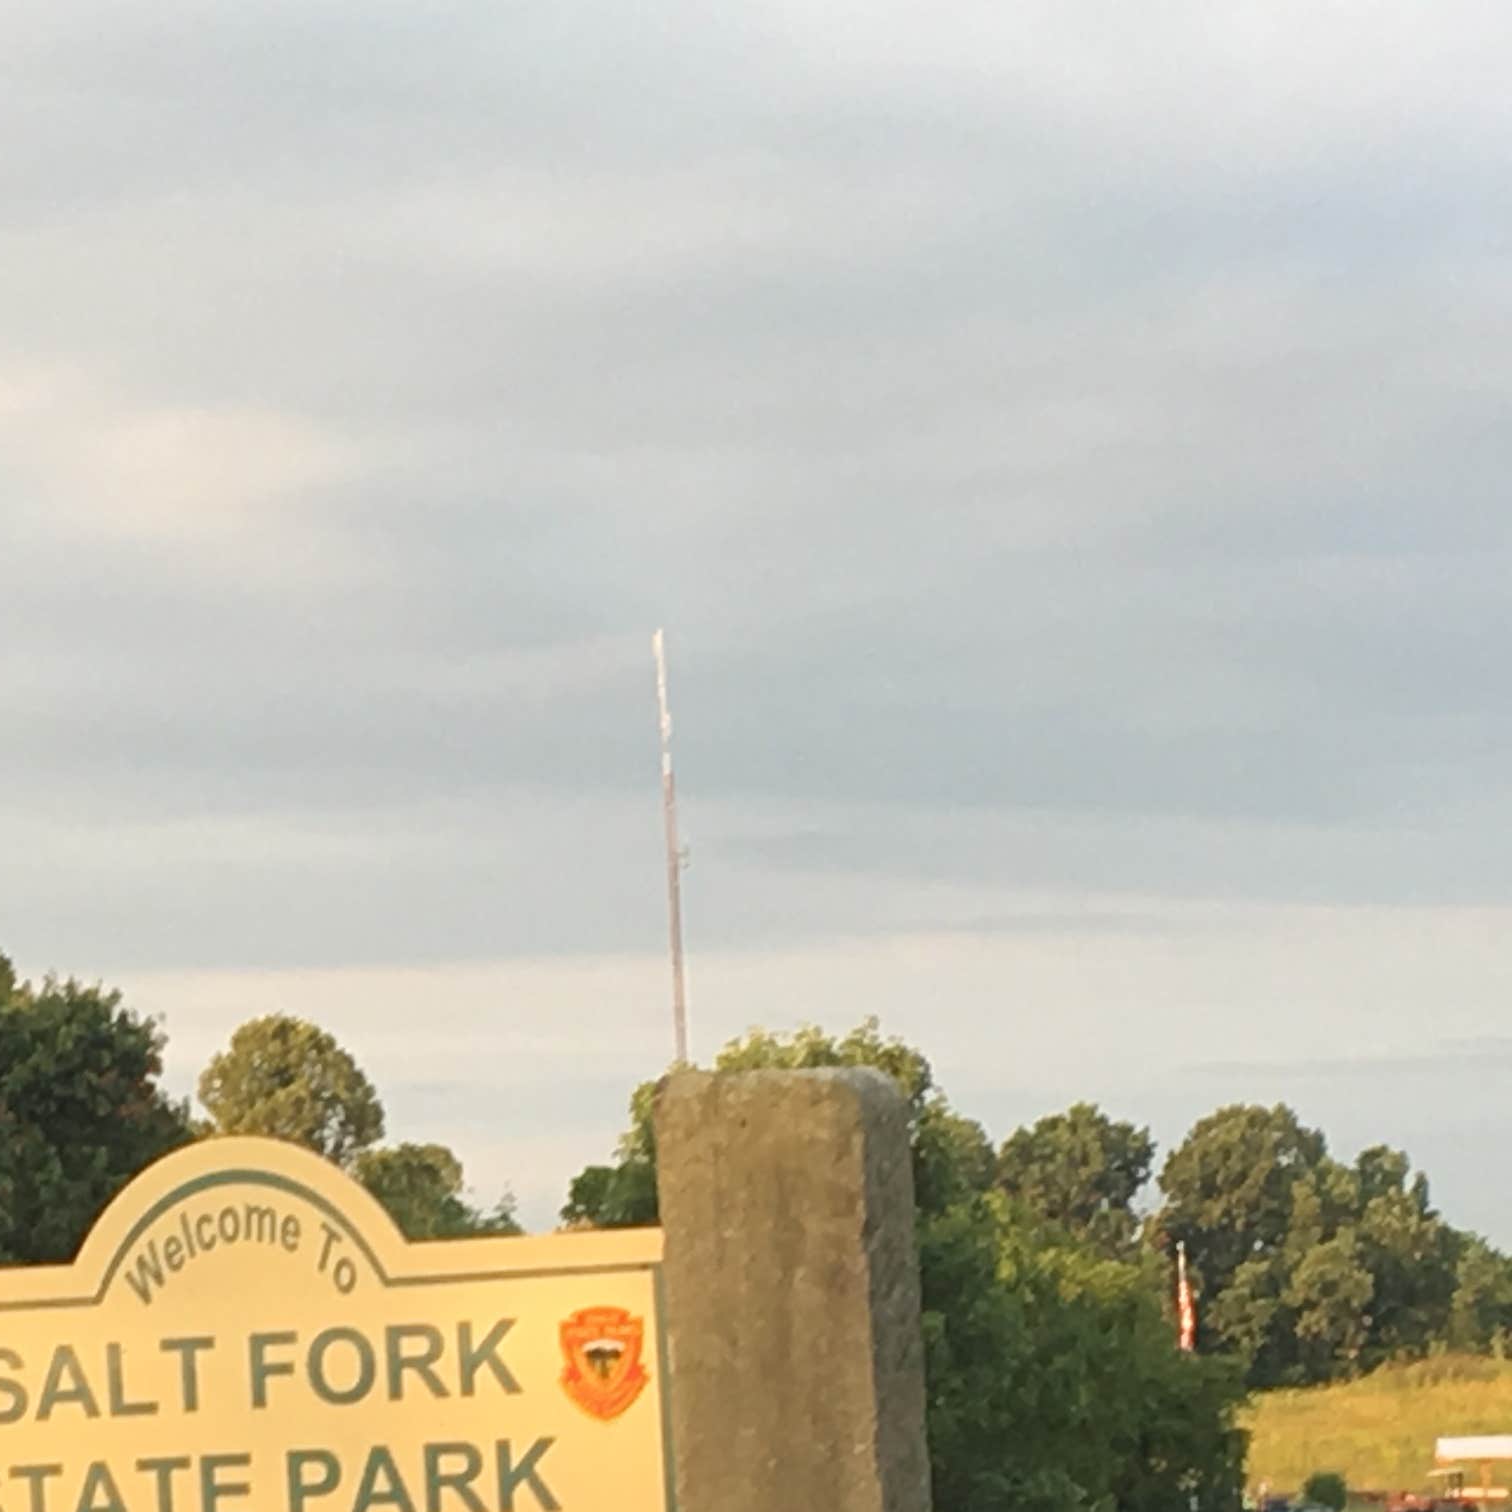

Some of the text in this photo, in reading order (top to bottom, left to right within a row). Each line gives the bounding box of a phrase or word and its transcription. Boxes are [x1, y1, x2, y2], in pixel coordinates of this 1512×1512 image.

[125, 1203, 357, 1306] Welcome To
[248, 1317, 523, 1408] FORK
